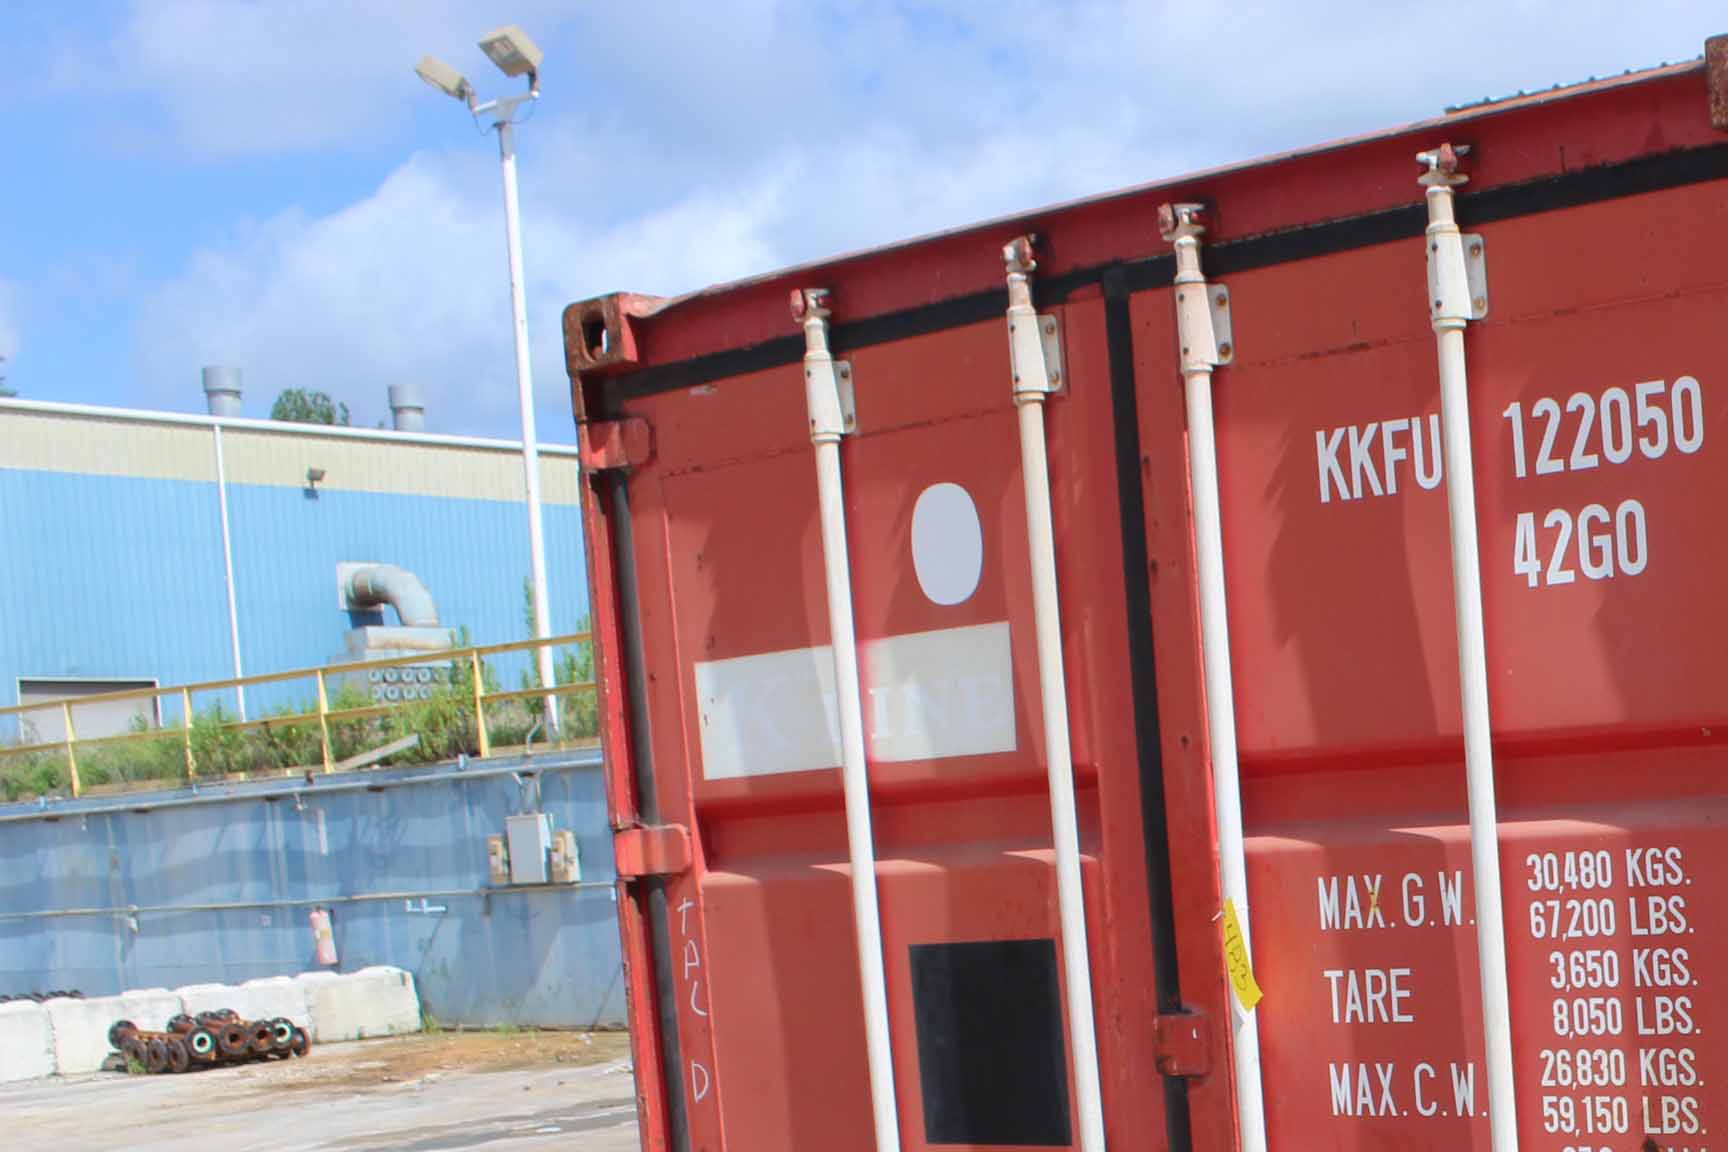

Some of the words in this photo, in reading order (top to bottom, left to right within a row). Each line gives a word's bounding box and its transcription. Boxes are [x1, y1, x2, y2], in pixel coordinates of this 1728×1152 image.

[1315, 414, 1443, 503] KKFU
[1502, 376, 1704, 478] 122050
[1525, 849, 1612, 894] 30,480
[1625, 847, 1692, 888] KGS.
[1529, 898, 1617, 942] 67,200
[1629, 895, 1696, 936] LBS.
[1322, 967, 1414, 1024] TARE
[1549, 949, 1620, 992] 3,650
[1632, 947, 1699, 988] KGS.
[1552, 998, 1623, 1039] 8,050
[1636, 996, 1702, 1036] LBS.
[1539, 1049, 1626, 1090] 26,830
[1639, 1047, 1705, 1088] KGS.
[1542, 1096, 1629, 1137] 59,150
[1641, 1095, 1708, 1135] LBS.
